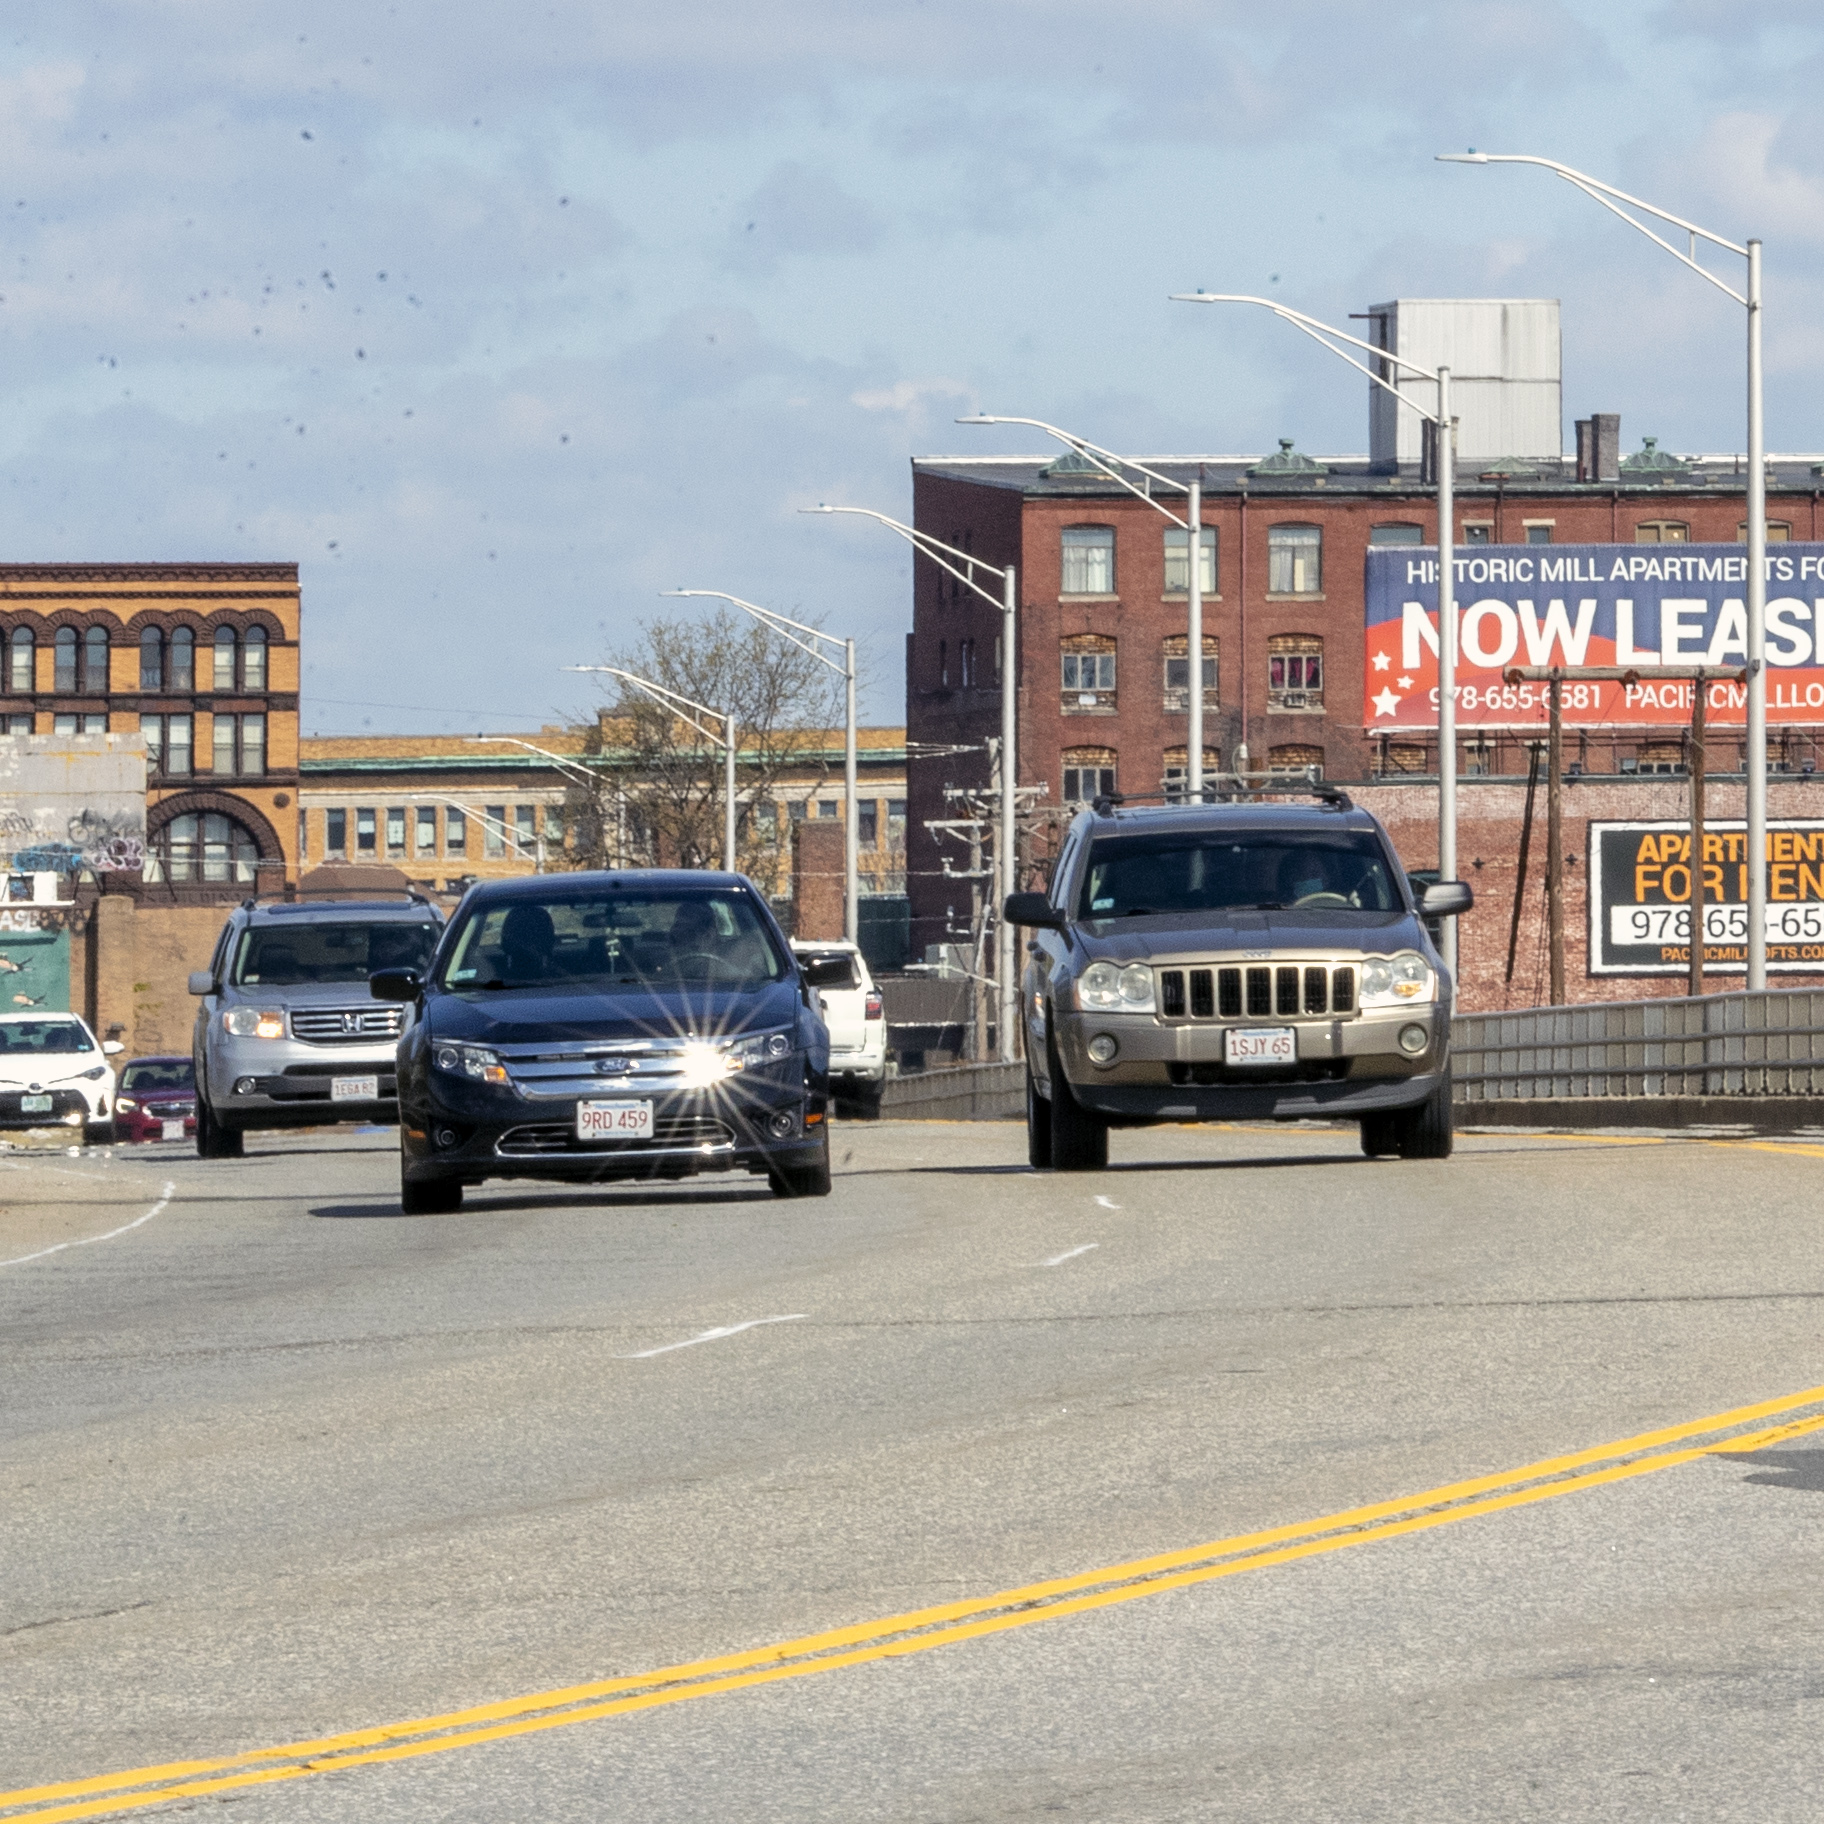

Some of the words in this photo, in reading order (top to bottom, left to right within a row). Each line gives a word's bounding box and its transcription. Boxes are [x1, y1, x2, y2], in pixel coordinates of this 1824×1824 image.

[1407, 557, 1533, 584] HITORIC
[1541, 557, 1604, 583] MILL
[1402, 598, 1598, 669] NOW
[1635, 864, 1724, 902] FOR
[1230, 1038, 1267, 1056] 1SJY
[1271, 1036, 1291, 1055] 65
[582, 1111, 612, 1129] 9RD
[618, 1110, 648, 1128] 459
